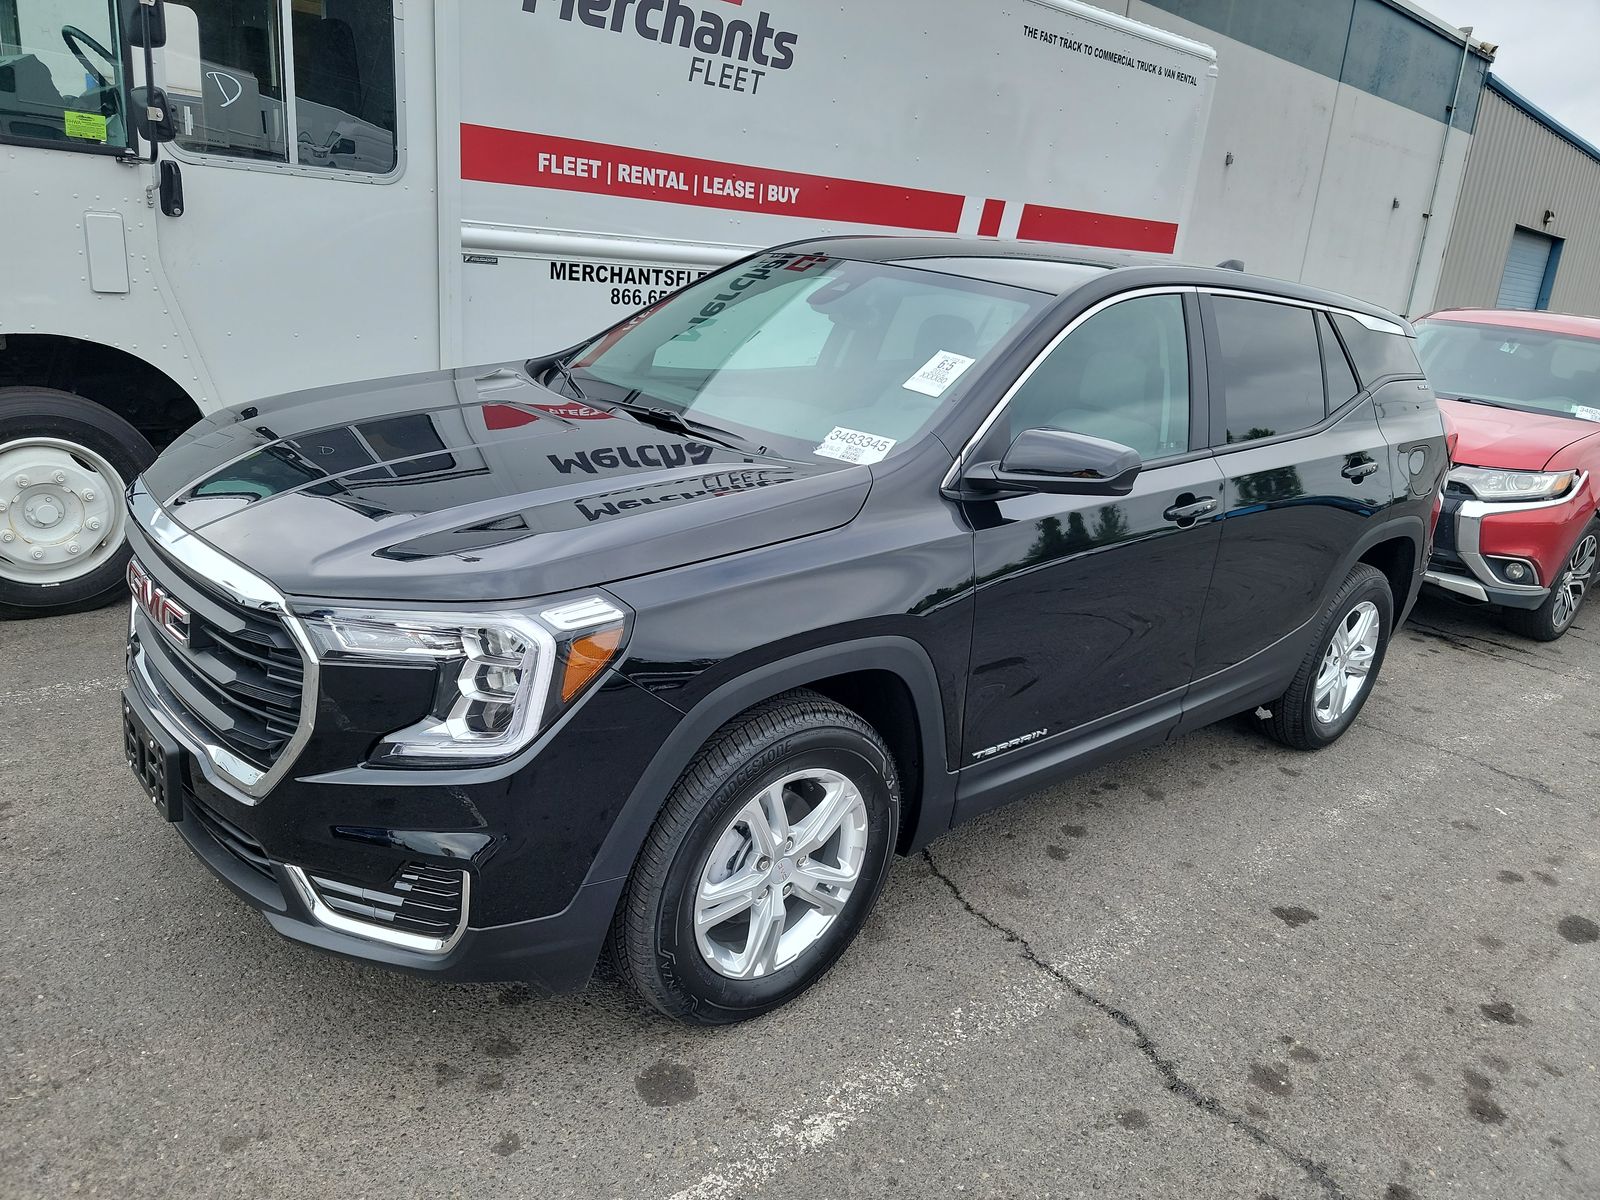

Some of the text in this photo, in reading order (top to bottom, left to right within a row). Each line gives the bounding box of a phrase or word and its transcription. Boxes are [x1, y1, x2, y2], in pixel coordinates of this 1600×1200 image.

[1023, 25, 1198, 86] THE FAST TRACK TO COMMERCIAL TRUCK & VAN RENTAL
[205, 71, 243, 108] D
[688, 56, 766, 95] FLEET
[538, 152, 602, 179] FLEET
[617, 163, 689, 191] RENTAL
[703, 176, 755, 199] LEASE
[767, 184, 800, 204] BUY
[830, 430, 890, 451] 3483345
[129, 560, 191, 647] GMC
[971, 728, 1048, 759] TERRAIN
